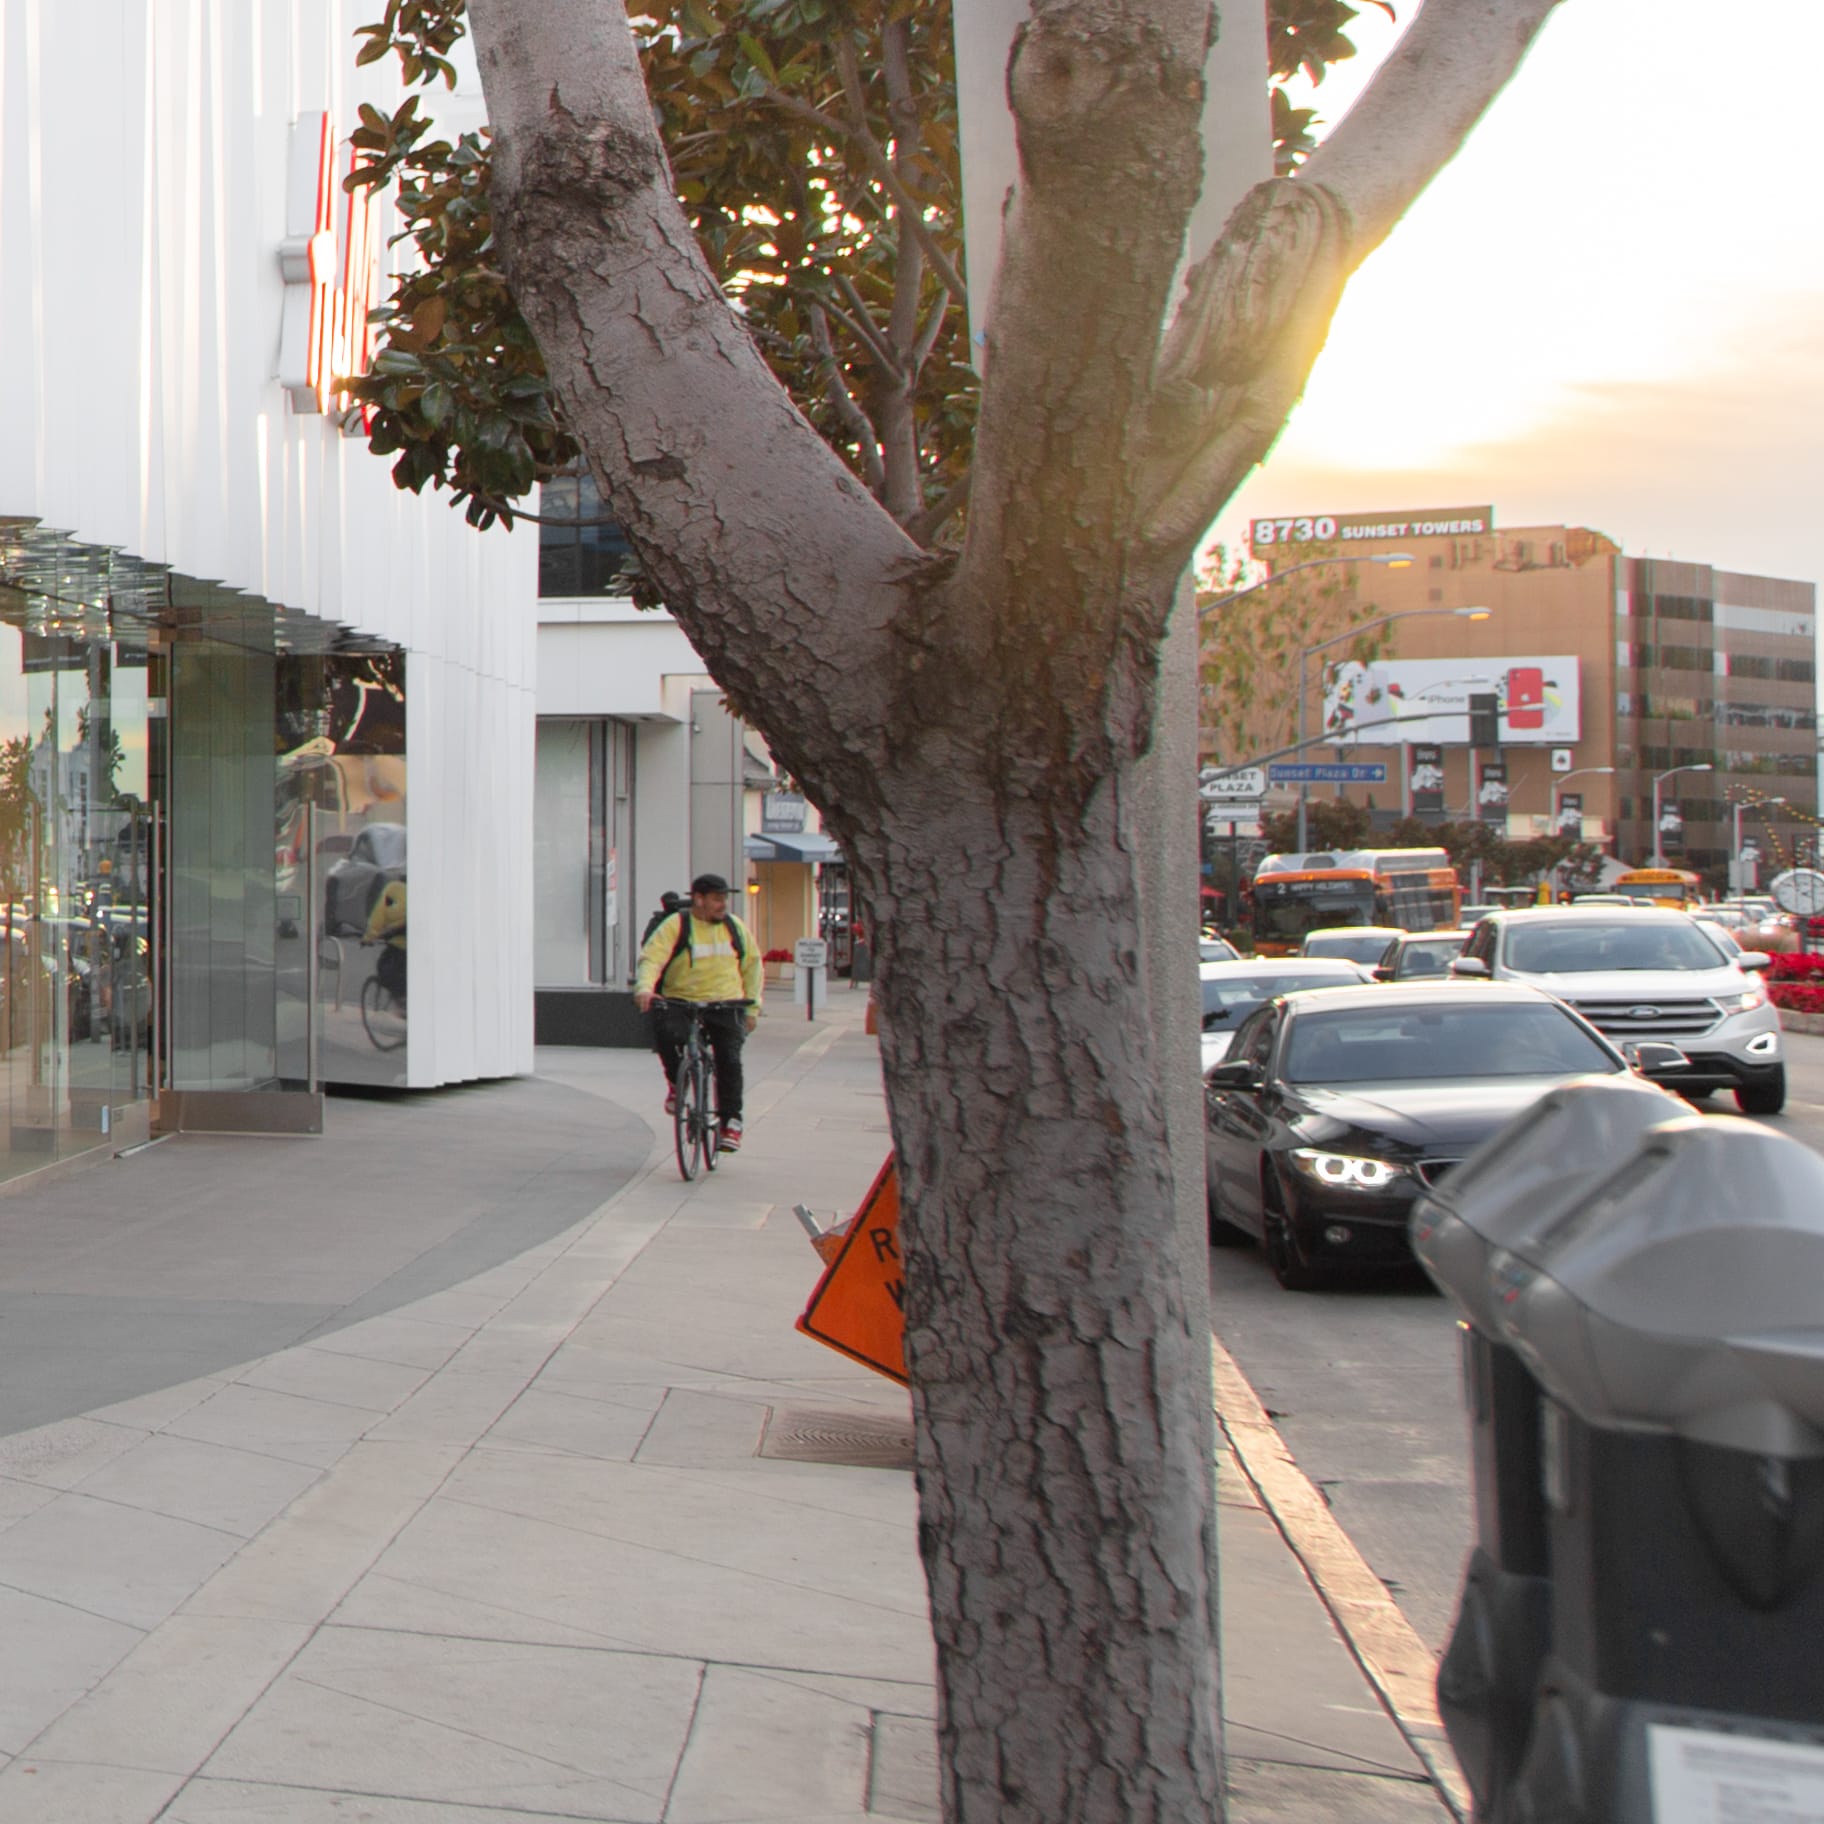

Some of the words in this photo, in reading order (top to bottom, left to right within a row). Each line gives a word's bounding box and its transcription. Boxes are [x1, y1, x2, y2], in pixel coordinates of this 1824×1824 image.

[1255, 516, 1337, 544] 8730
[1341, 523, 1408, 539] SUNSET
[1411, 519, 1483, 535] TOWERS
[1209, 783, 1254, 792] PLAZA
[1277, 882, 1286, 895] 2
